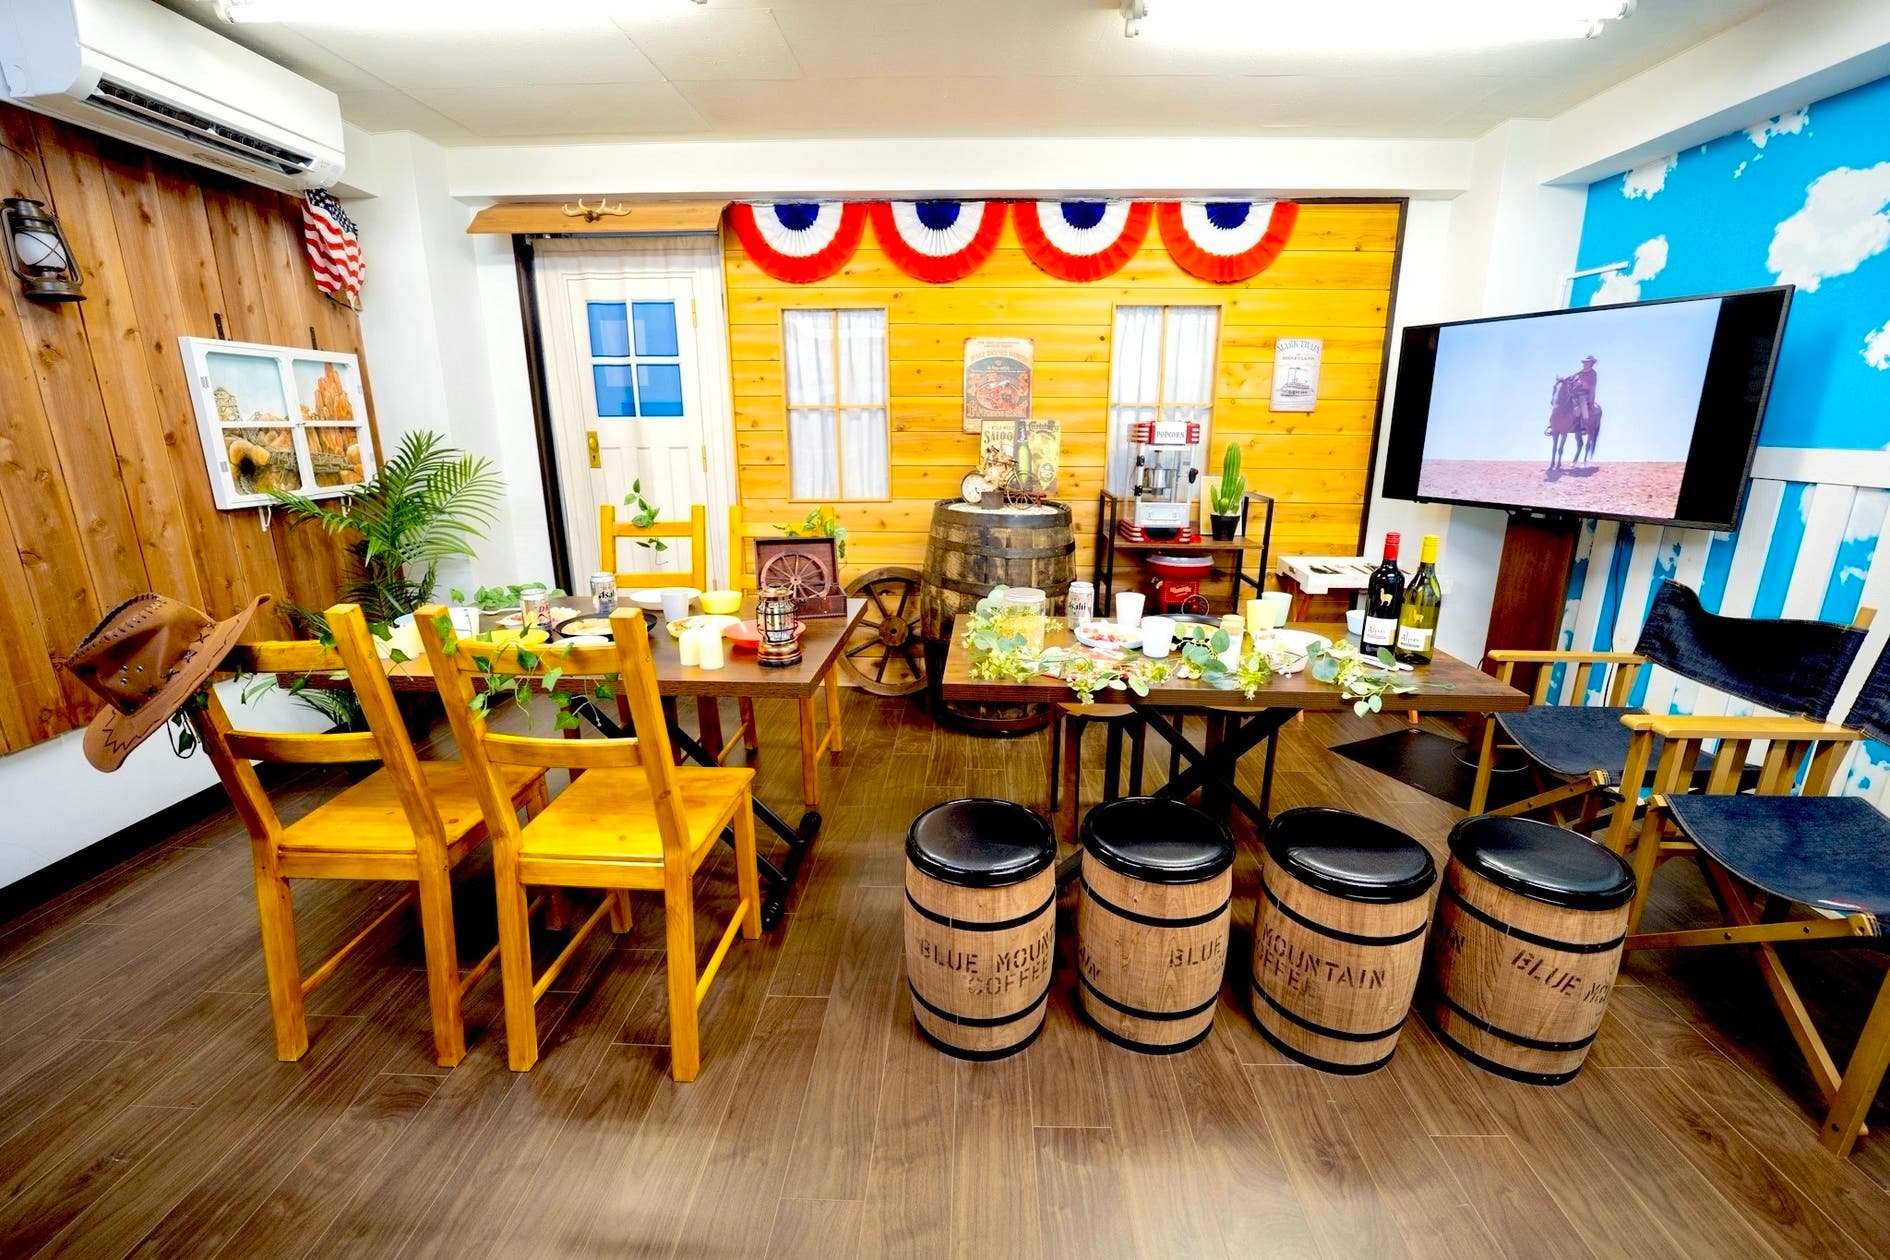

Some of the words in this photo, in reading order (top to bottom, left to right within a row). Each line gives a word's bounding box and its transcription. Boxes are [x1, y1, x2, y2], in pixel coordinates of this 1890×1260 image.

[1156, 431, 1185, 439] POPCORN
[920, 937, 979, 974] BLUE
[1169, 934, 1223, 968] BLUE
[1262, 923, 1385, 989] MOUNTAIN
[968, 952, 1049, 996] COFFEE
[1511, 949, 1582, 997] BLUE
